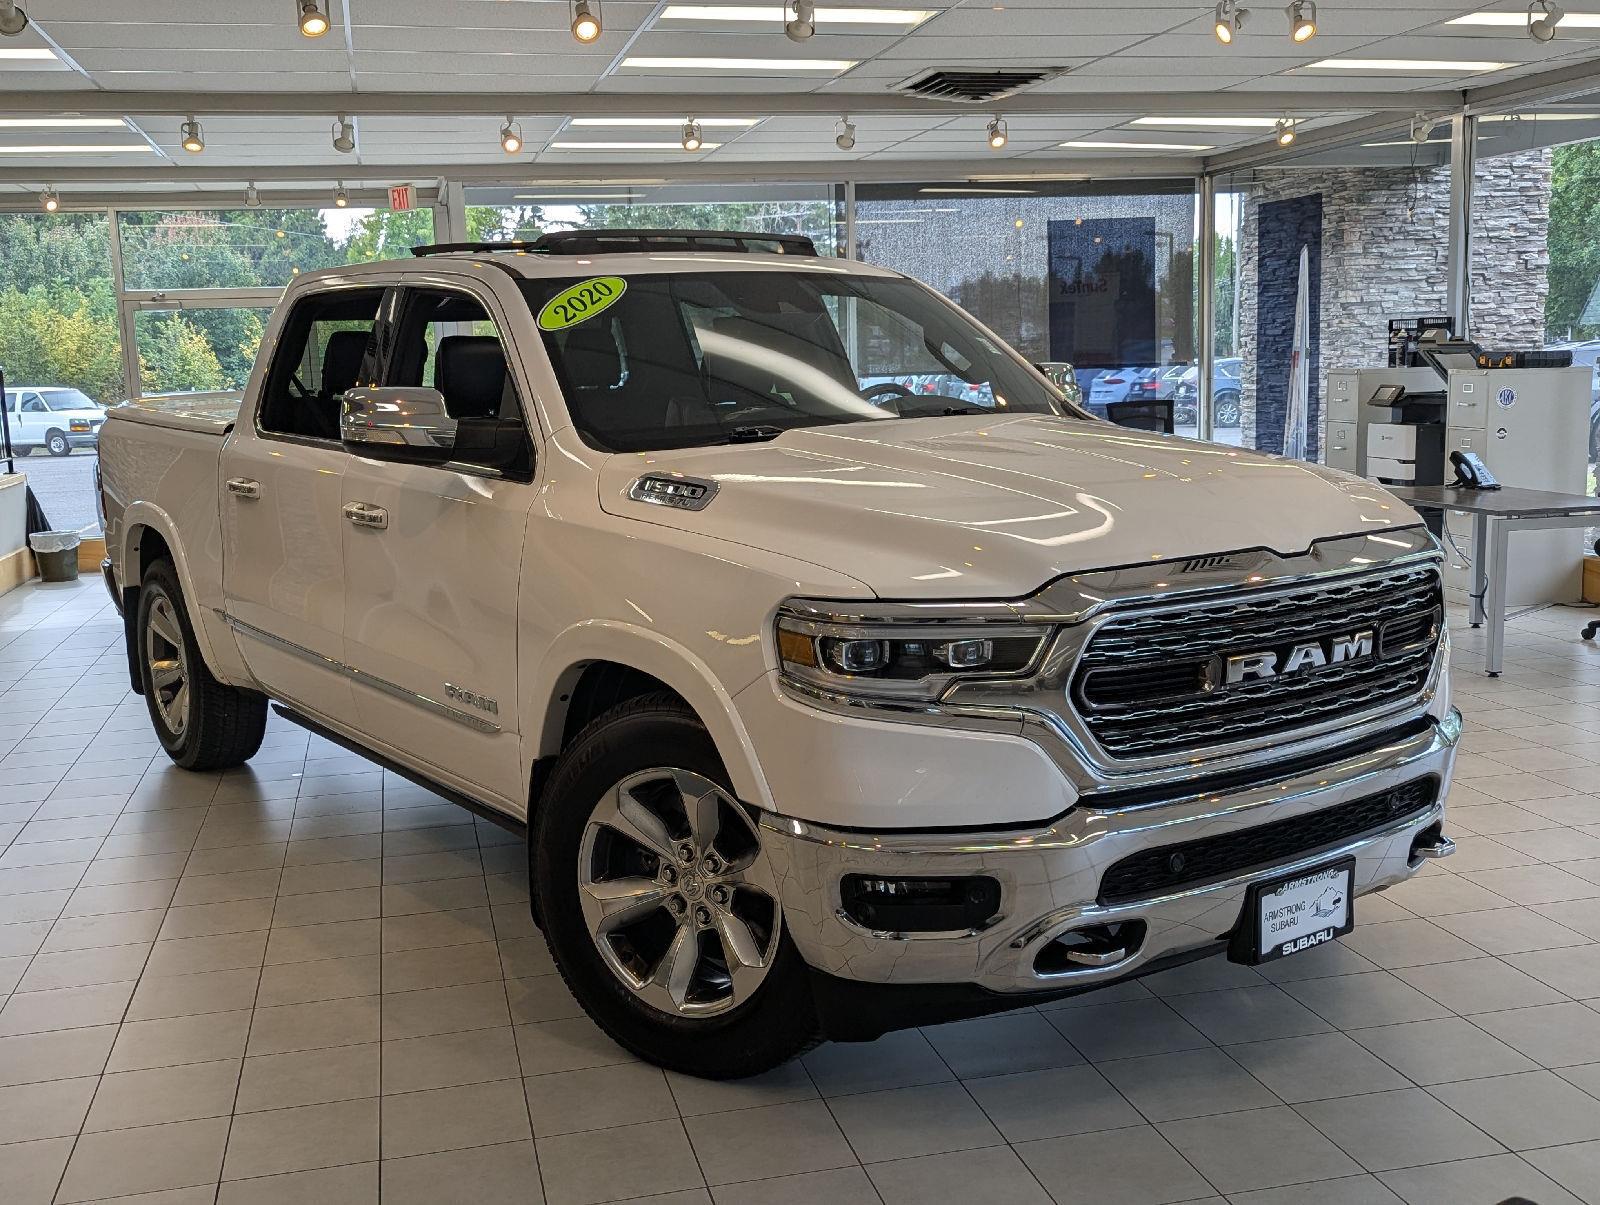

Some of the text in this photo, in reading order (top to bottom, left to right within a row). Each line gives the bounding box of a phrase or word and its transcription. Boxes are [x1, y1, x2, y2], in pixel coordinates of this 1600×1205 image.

[391, 187, 410, 210] EXIT
[553, 281, 613, 323] 2020
[644, 479, 704, 499] 1500
[1226, 630, 1374, 684] RAM
[444, 682, 499, 716] RAM
[1282, 868, 1336, 893] ARMSTRONG
[1264, 900, 1306, 923] ARMSTRONG
[1270, 916, 1299, 933] SUBARU
[1282, 928, 1334, 956] SUBARU
